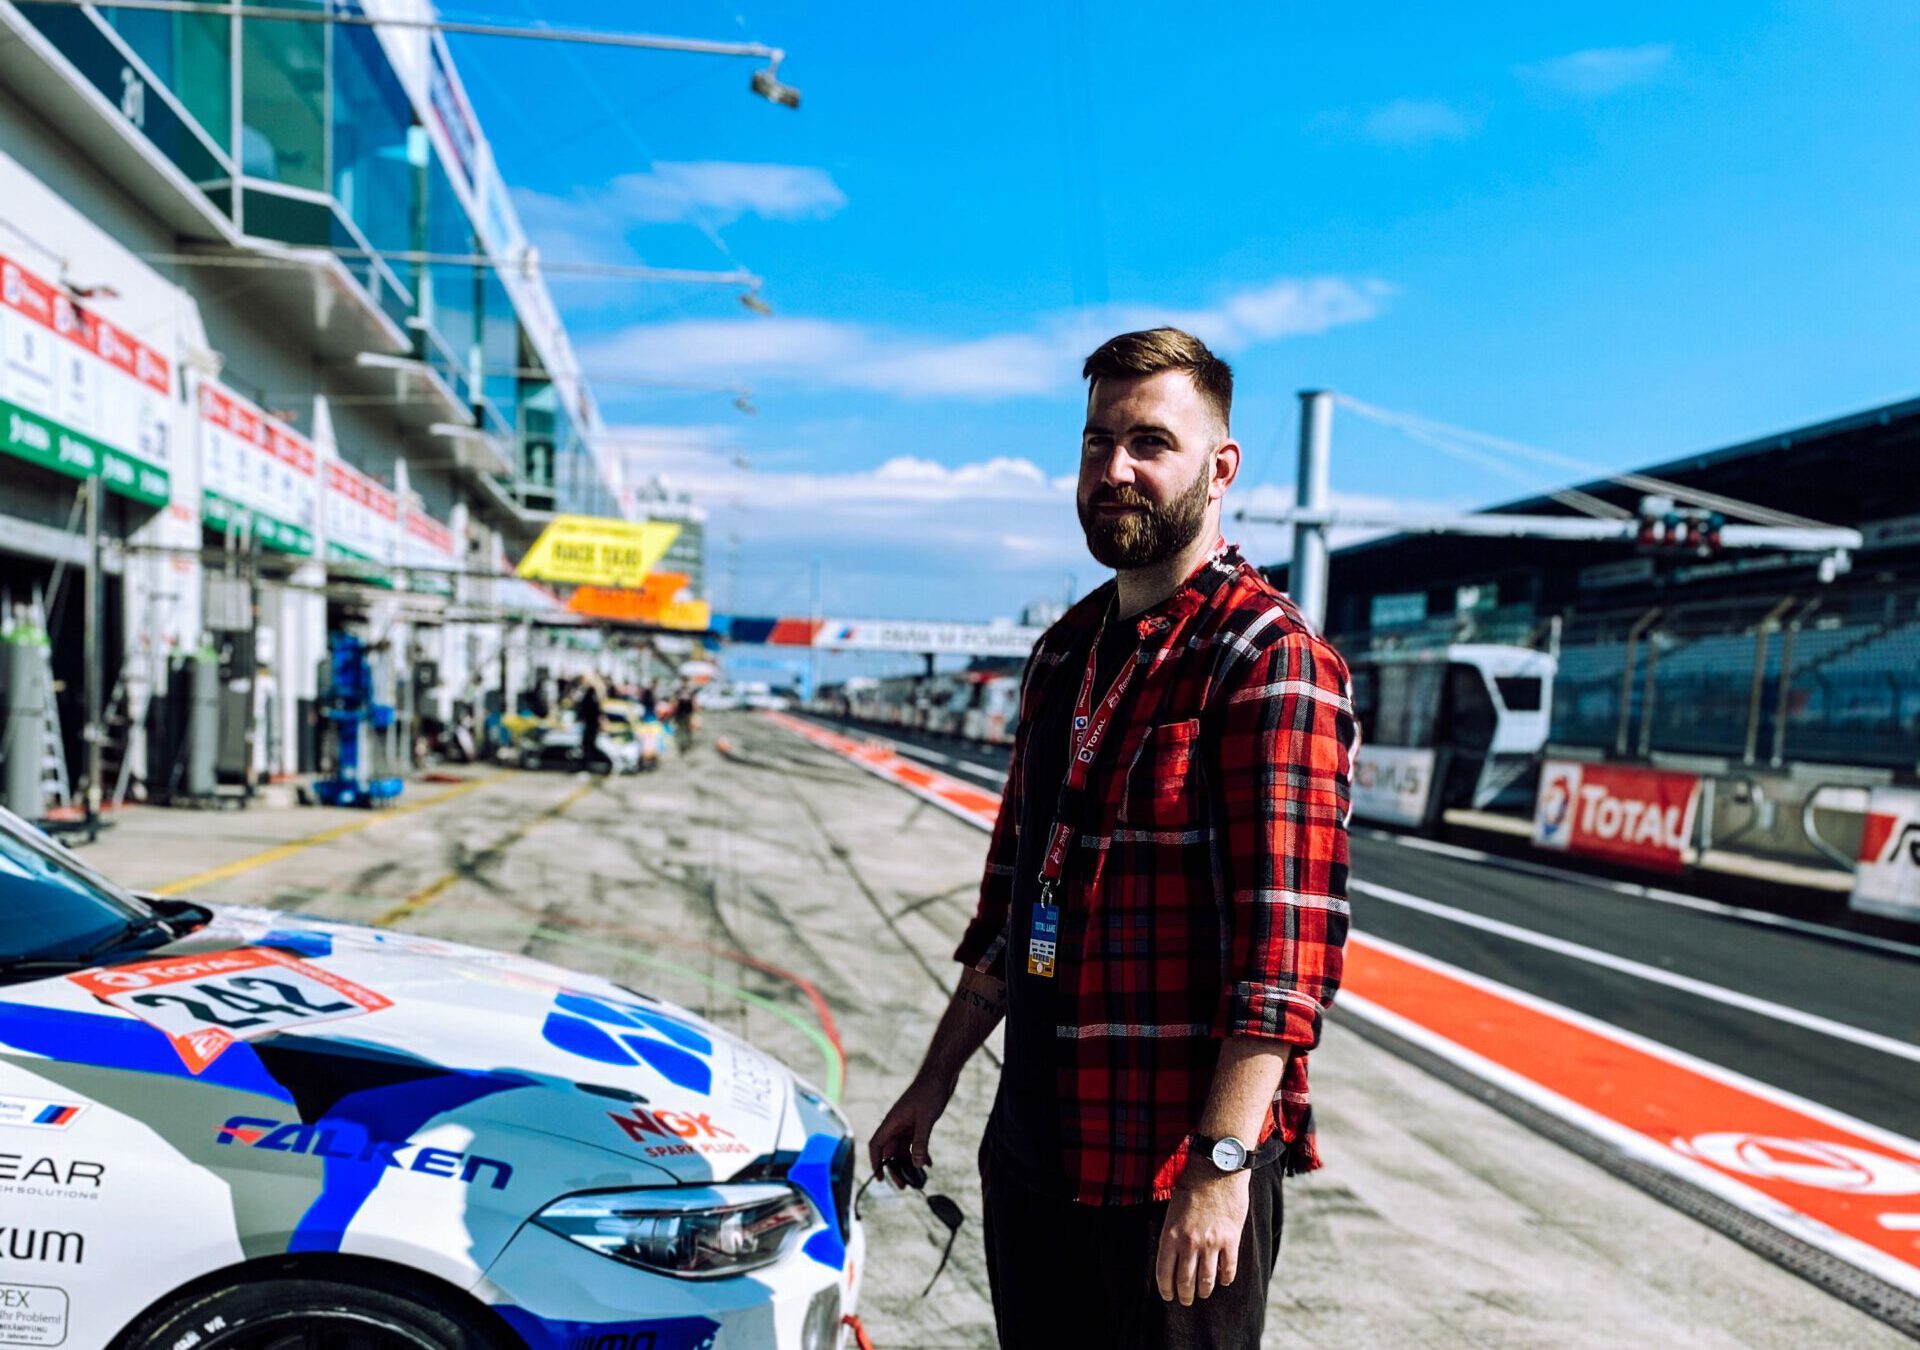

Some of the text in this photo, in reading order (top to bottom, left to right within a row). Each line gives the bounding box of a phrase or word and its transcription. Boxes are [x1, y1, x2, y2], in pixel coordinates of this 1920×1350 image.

[1086, 717, 1106, 748] TOTAL
[1581, 783, 1684, 850] TOTAL
[148, 957, 254, 980] TOTAL
[131, 976, 358, 1030] 242
[606, 1107, 736, 1143] NGK
[214, 1115, 514, 1191] FALKEN
[644, 1143, 695, 1158] SPARK
[16, 1186, 99, 1200] SOLUTIONS
